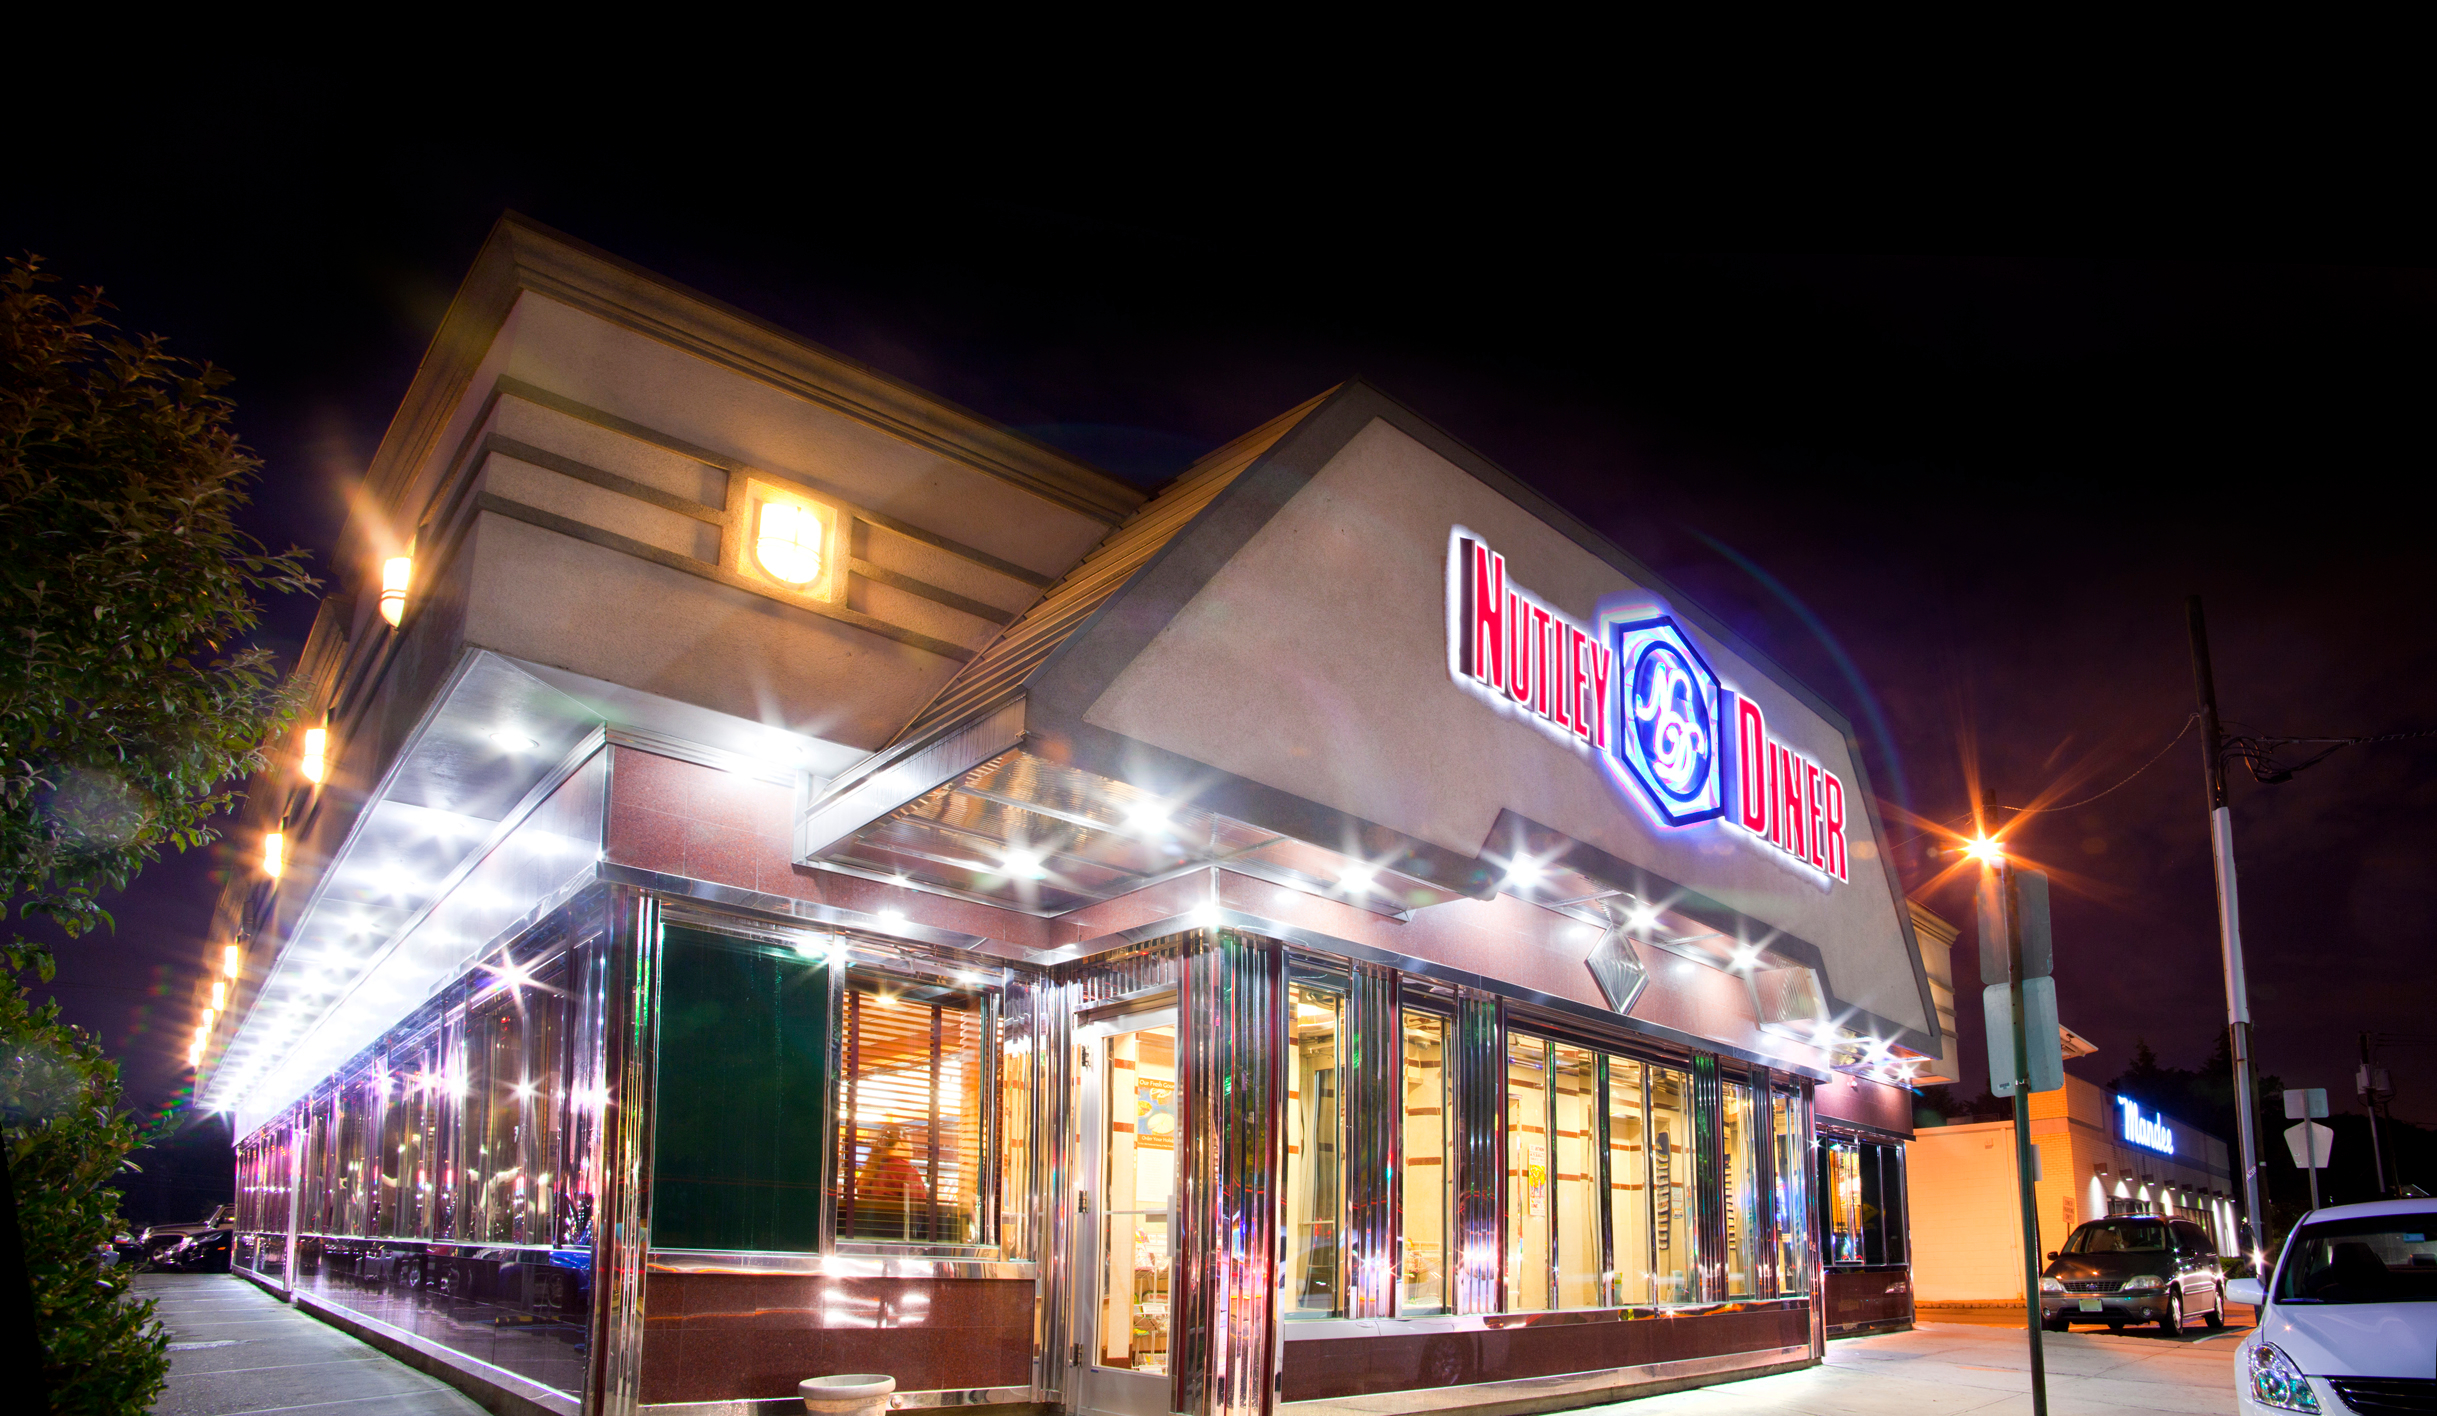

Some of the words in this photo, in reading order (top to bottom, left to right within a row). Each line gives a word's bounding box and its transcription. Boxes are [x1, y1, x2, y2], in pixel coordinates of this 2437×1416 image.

[1472, 539, 1613, 753] NUTLEY
[1736, 691, 1850, 885] DINER
[1139, 1079, 1149, 1087] Our
[1150, 1080, 1163, 1088] Fresh
[2117, 1094, 2175, 1155] Mandee
